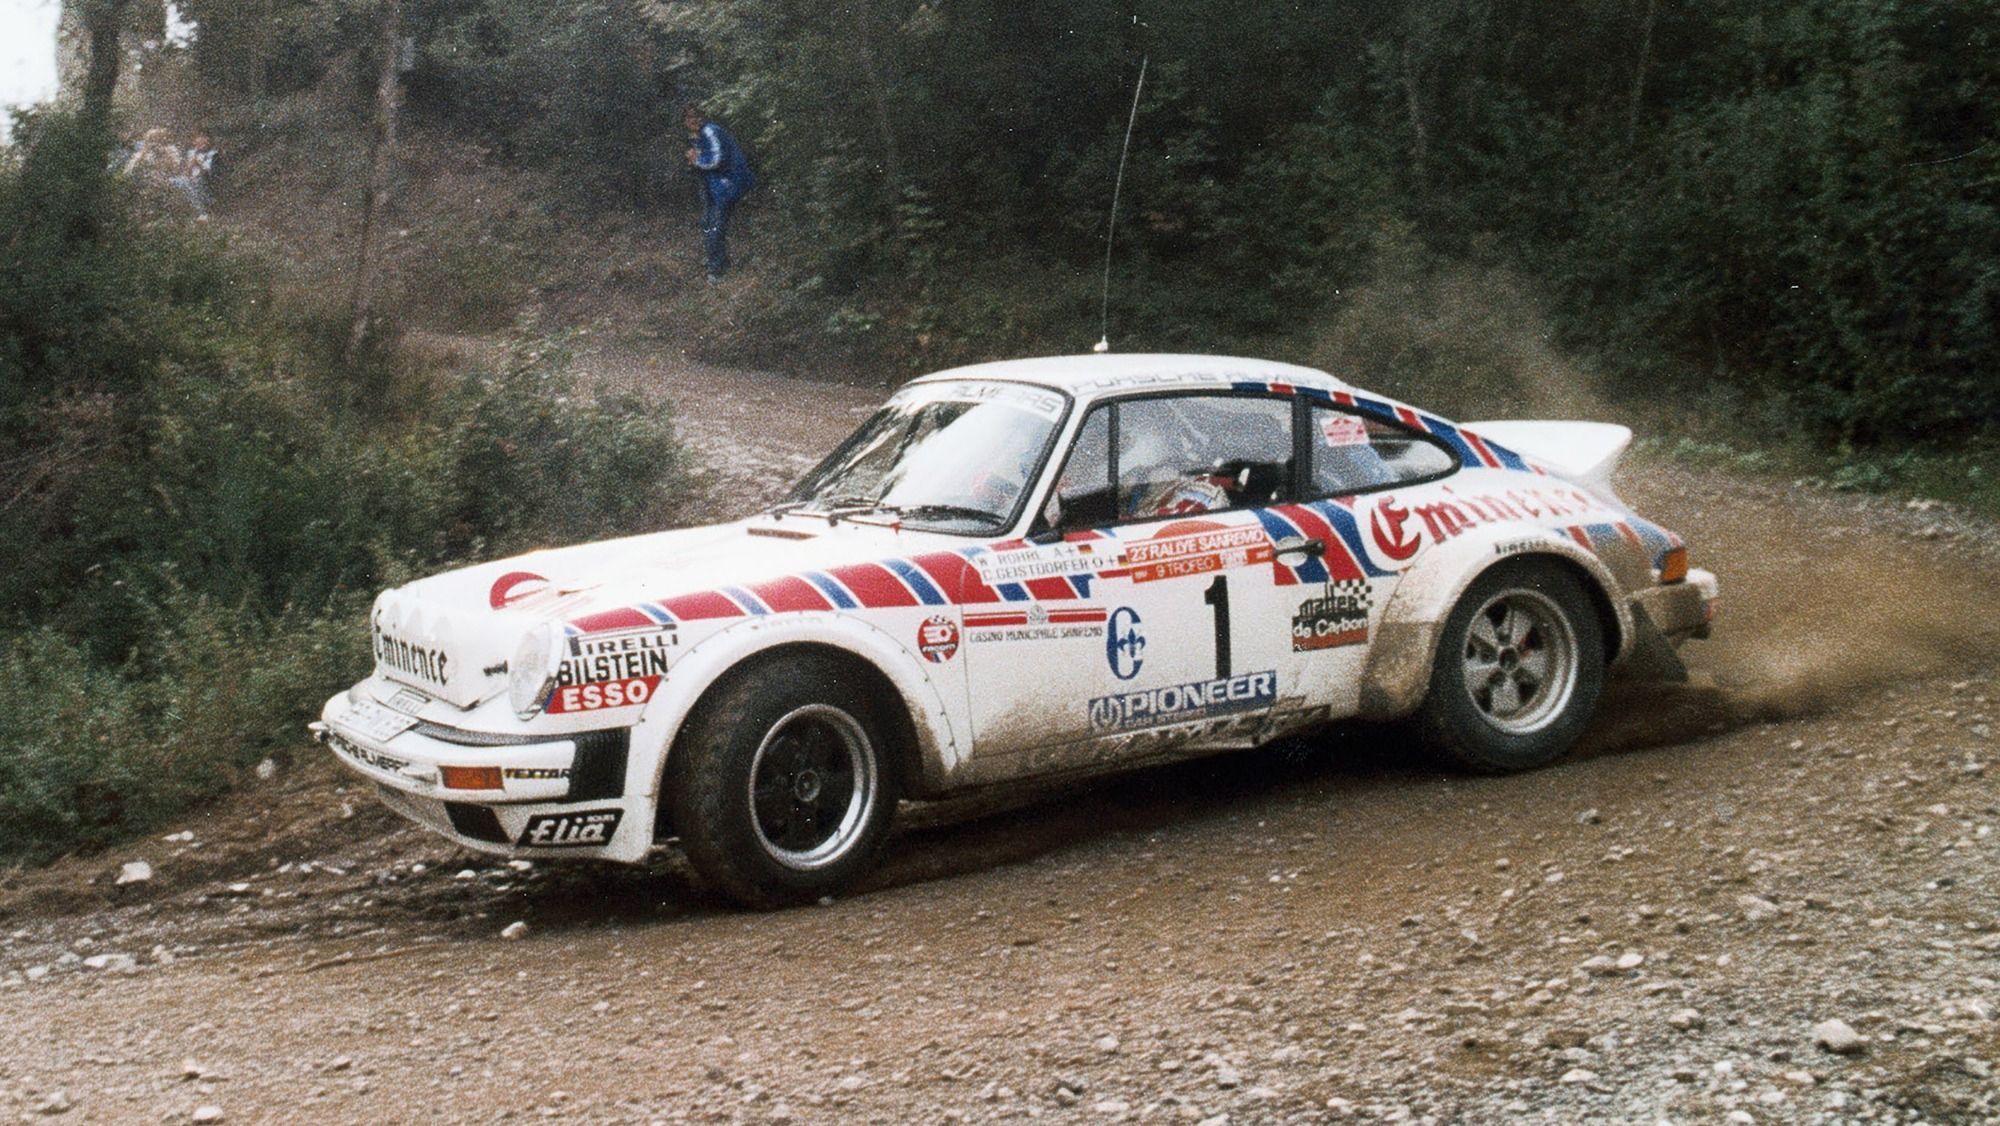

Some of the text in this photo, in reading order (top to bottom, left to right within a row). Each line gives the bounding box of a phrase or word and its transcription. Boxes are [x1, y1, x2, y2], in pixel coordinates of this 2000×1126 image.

[1198, 529, 1265, 551] SANREMO
[1168, 556, 1215, 575] TROFEO
[1205, 575, 1231, 681] 1
[1315, 618, 1367, 637] Carbon
[569, 633, 678, 656] PIRELLI
[557, 648, 668, 686] BILSTEIN
[562, 680, 649, 712] ESSO
[1125, 673, 1272, 718] PIONEER
[504, 768, 571, 779] TEXTAR
